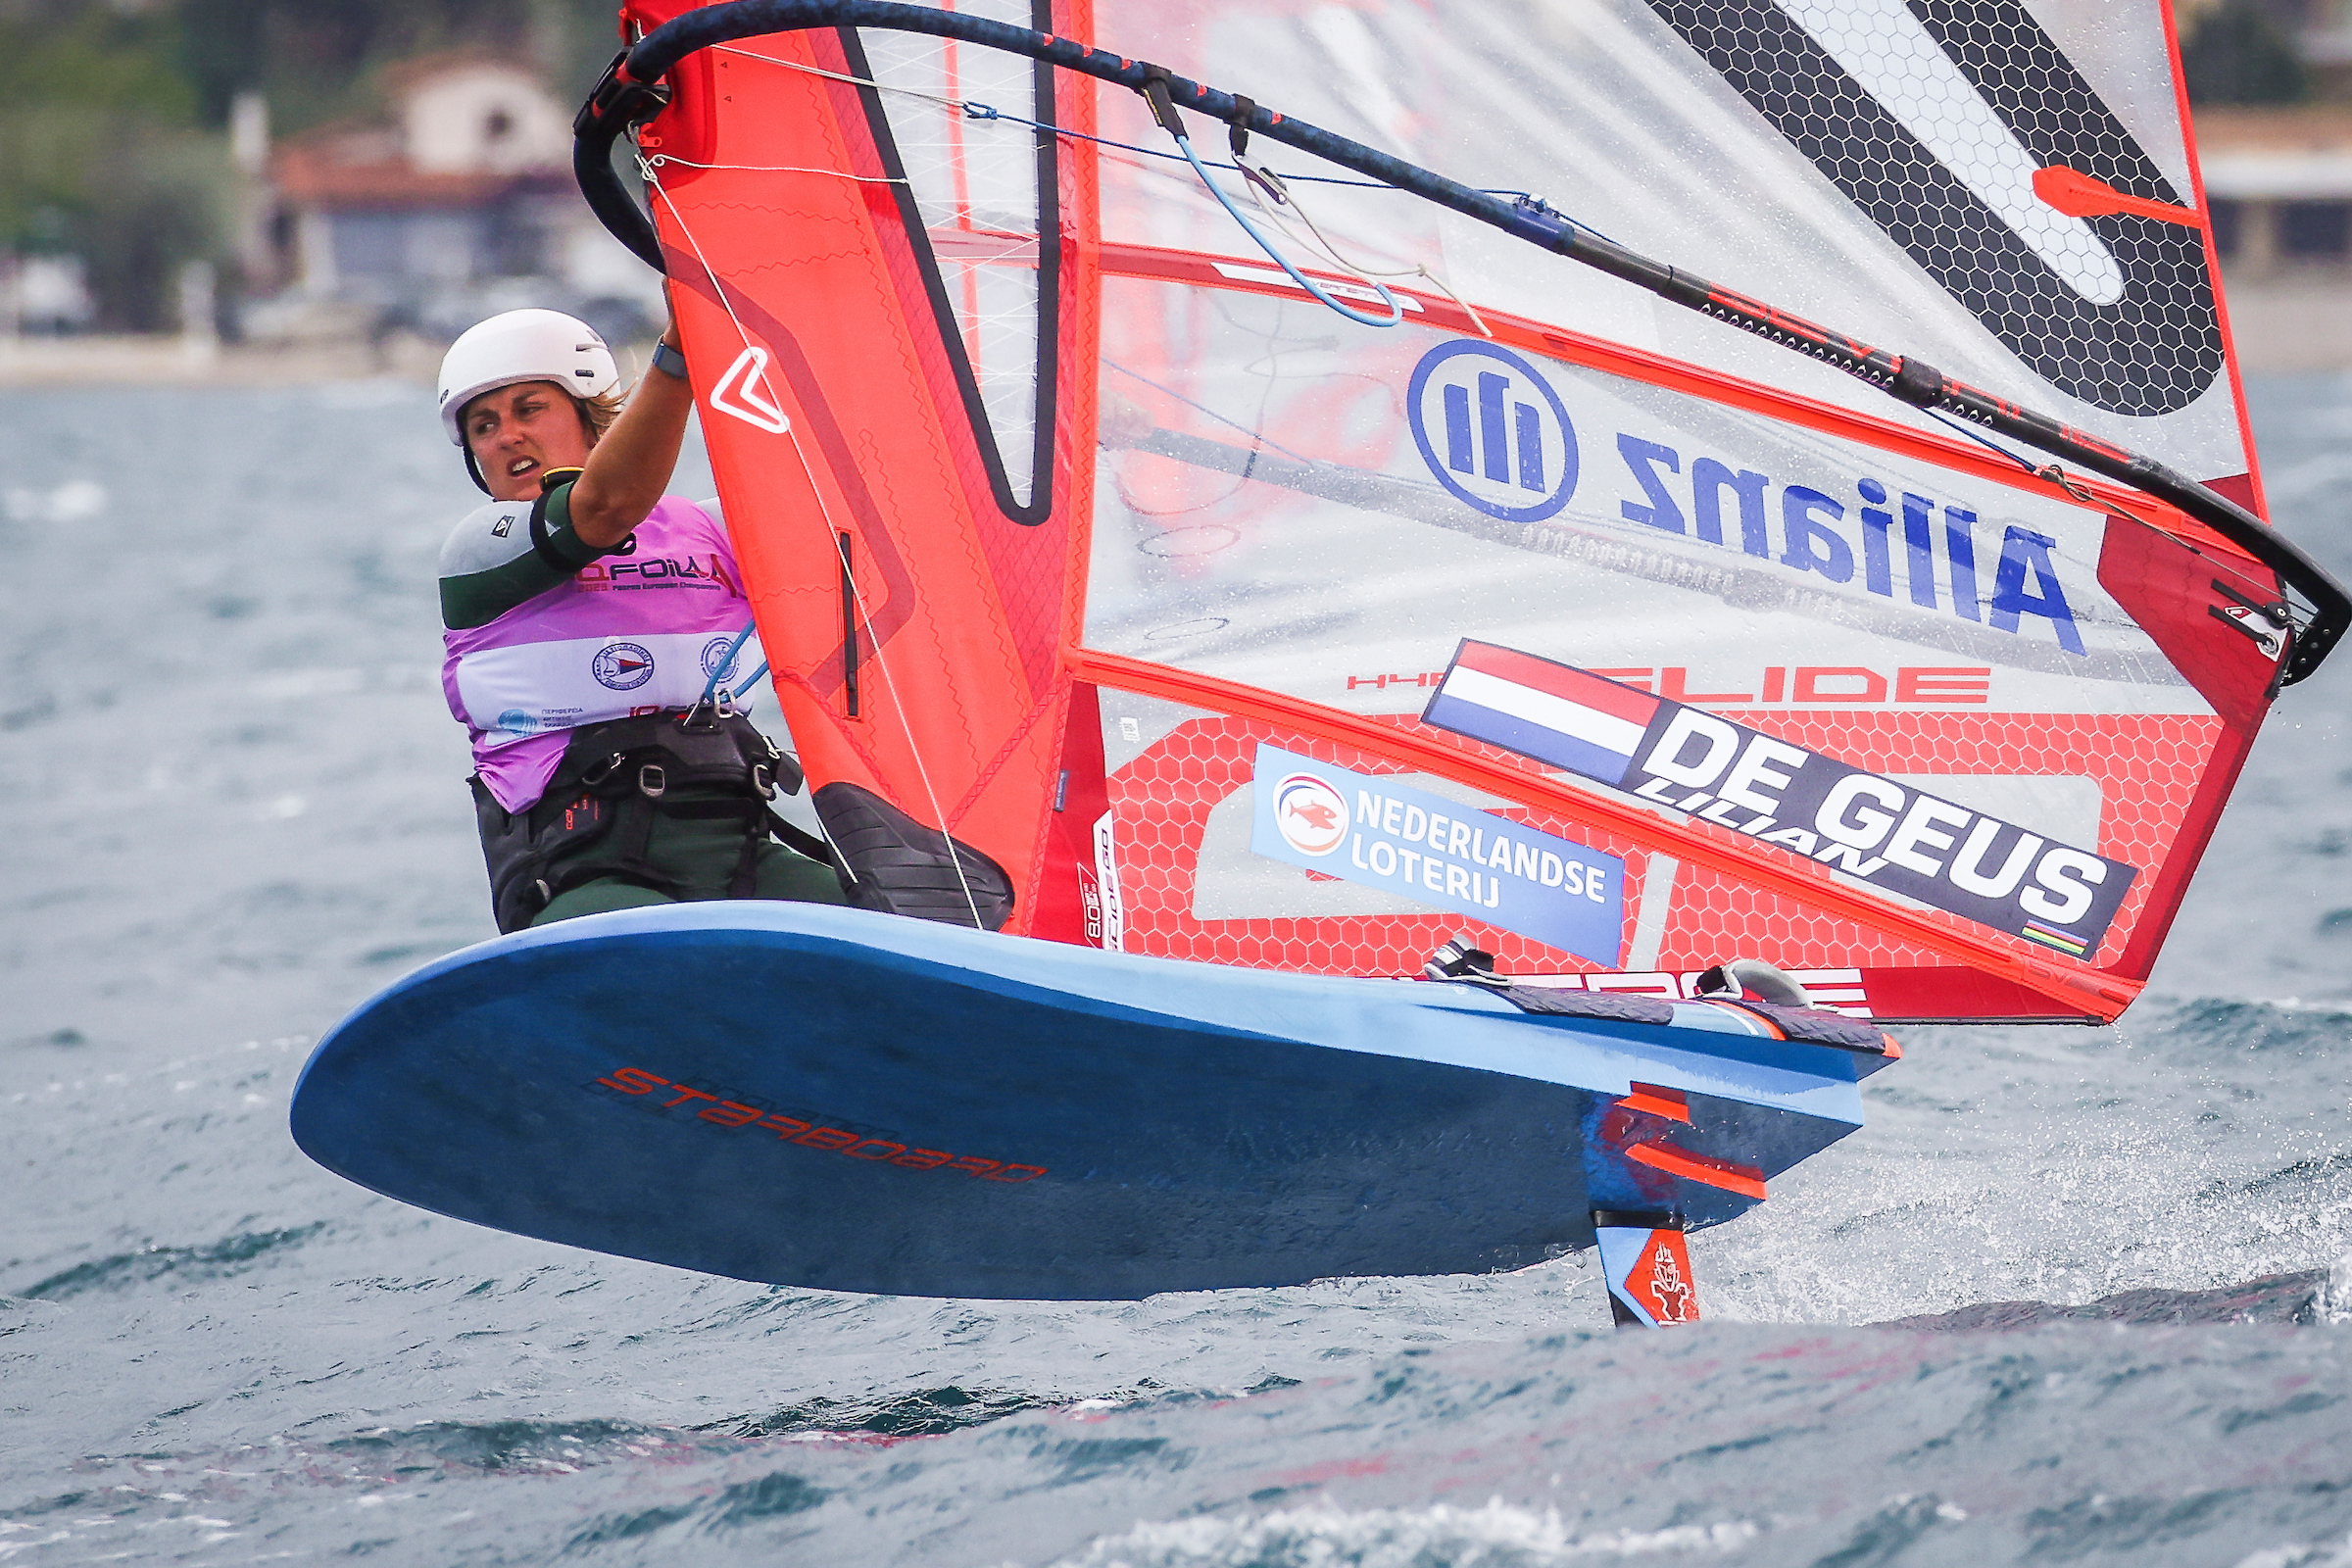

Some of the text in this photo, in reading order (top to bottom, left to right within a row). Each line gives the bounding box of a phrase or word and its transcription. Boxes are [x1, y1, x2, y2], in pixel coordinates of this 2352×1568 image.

[1356, 789, 1608, 904] NEDERLANDSE
[1634, 776, 1891, 877] LILIAN
[1642, 707, 2108, 925] DE GEUS
[1351, 832, 1501, 909] LOTERIJ
